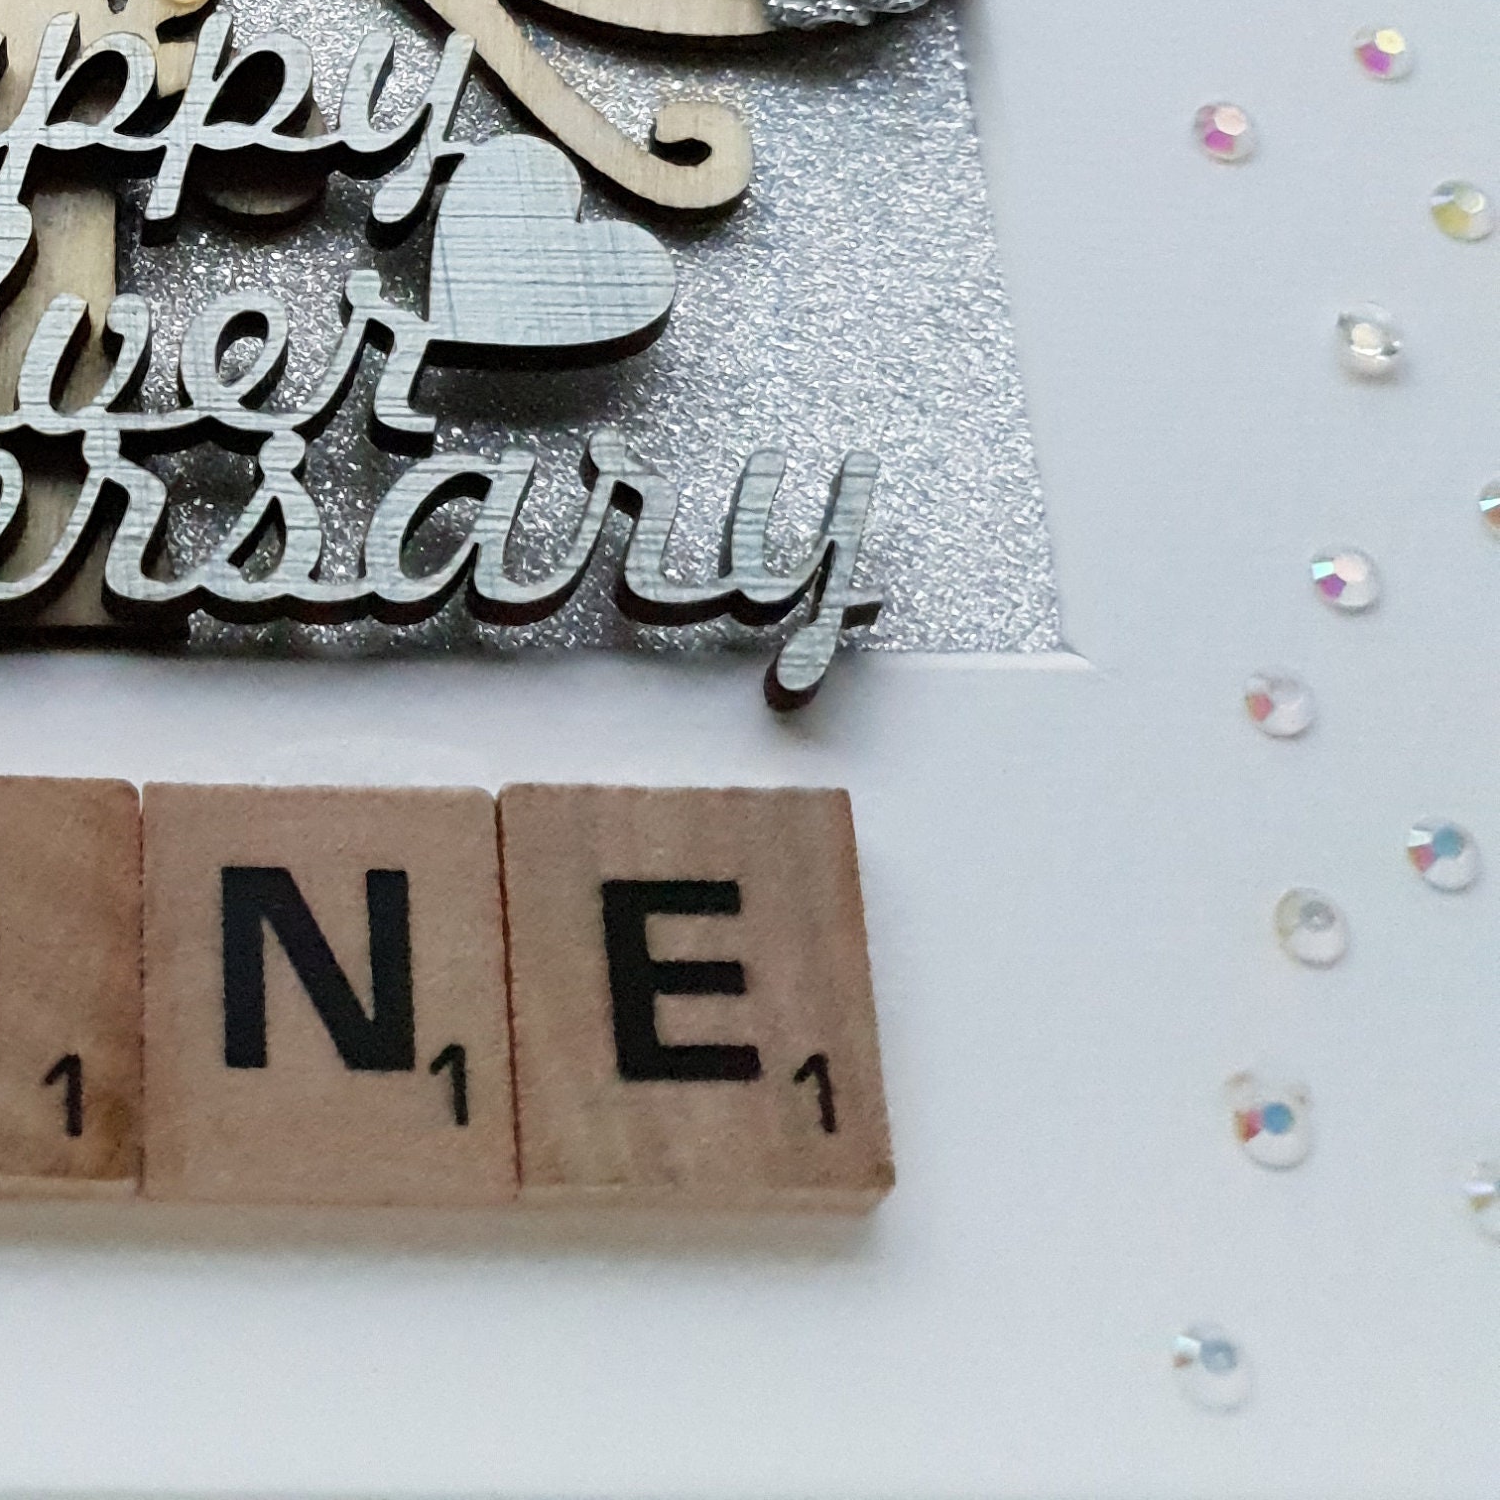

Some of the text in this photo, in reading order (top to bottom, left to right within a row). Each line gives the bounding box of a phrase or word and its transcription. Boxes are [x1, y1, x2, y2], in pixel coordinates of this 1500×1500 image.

[44, 1052, 84, 1138] 1
[430, 1042, 470, 1127] 1
[793, 1051, 837, 1135] 1
